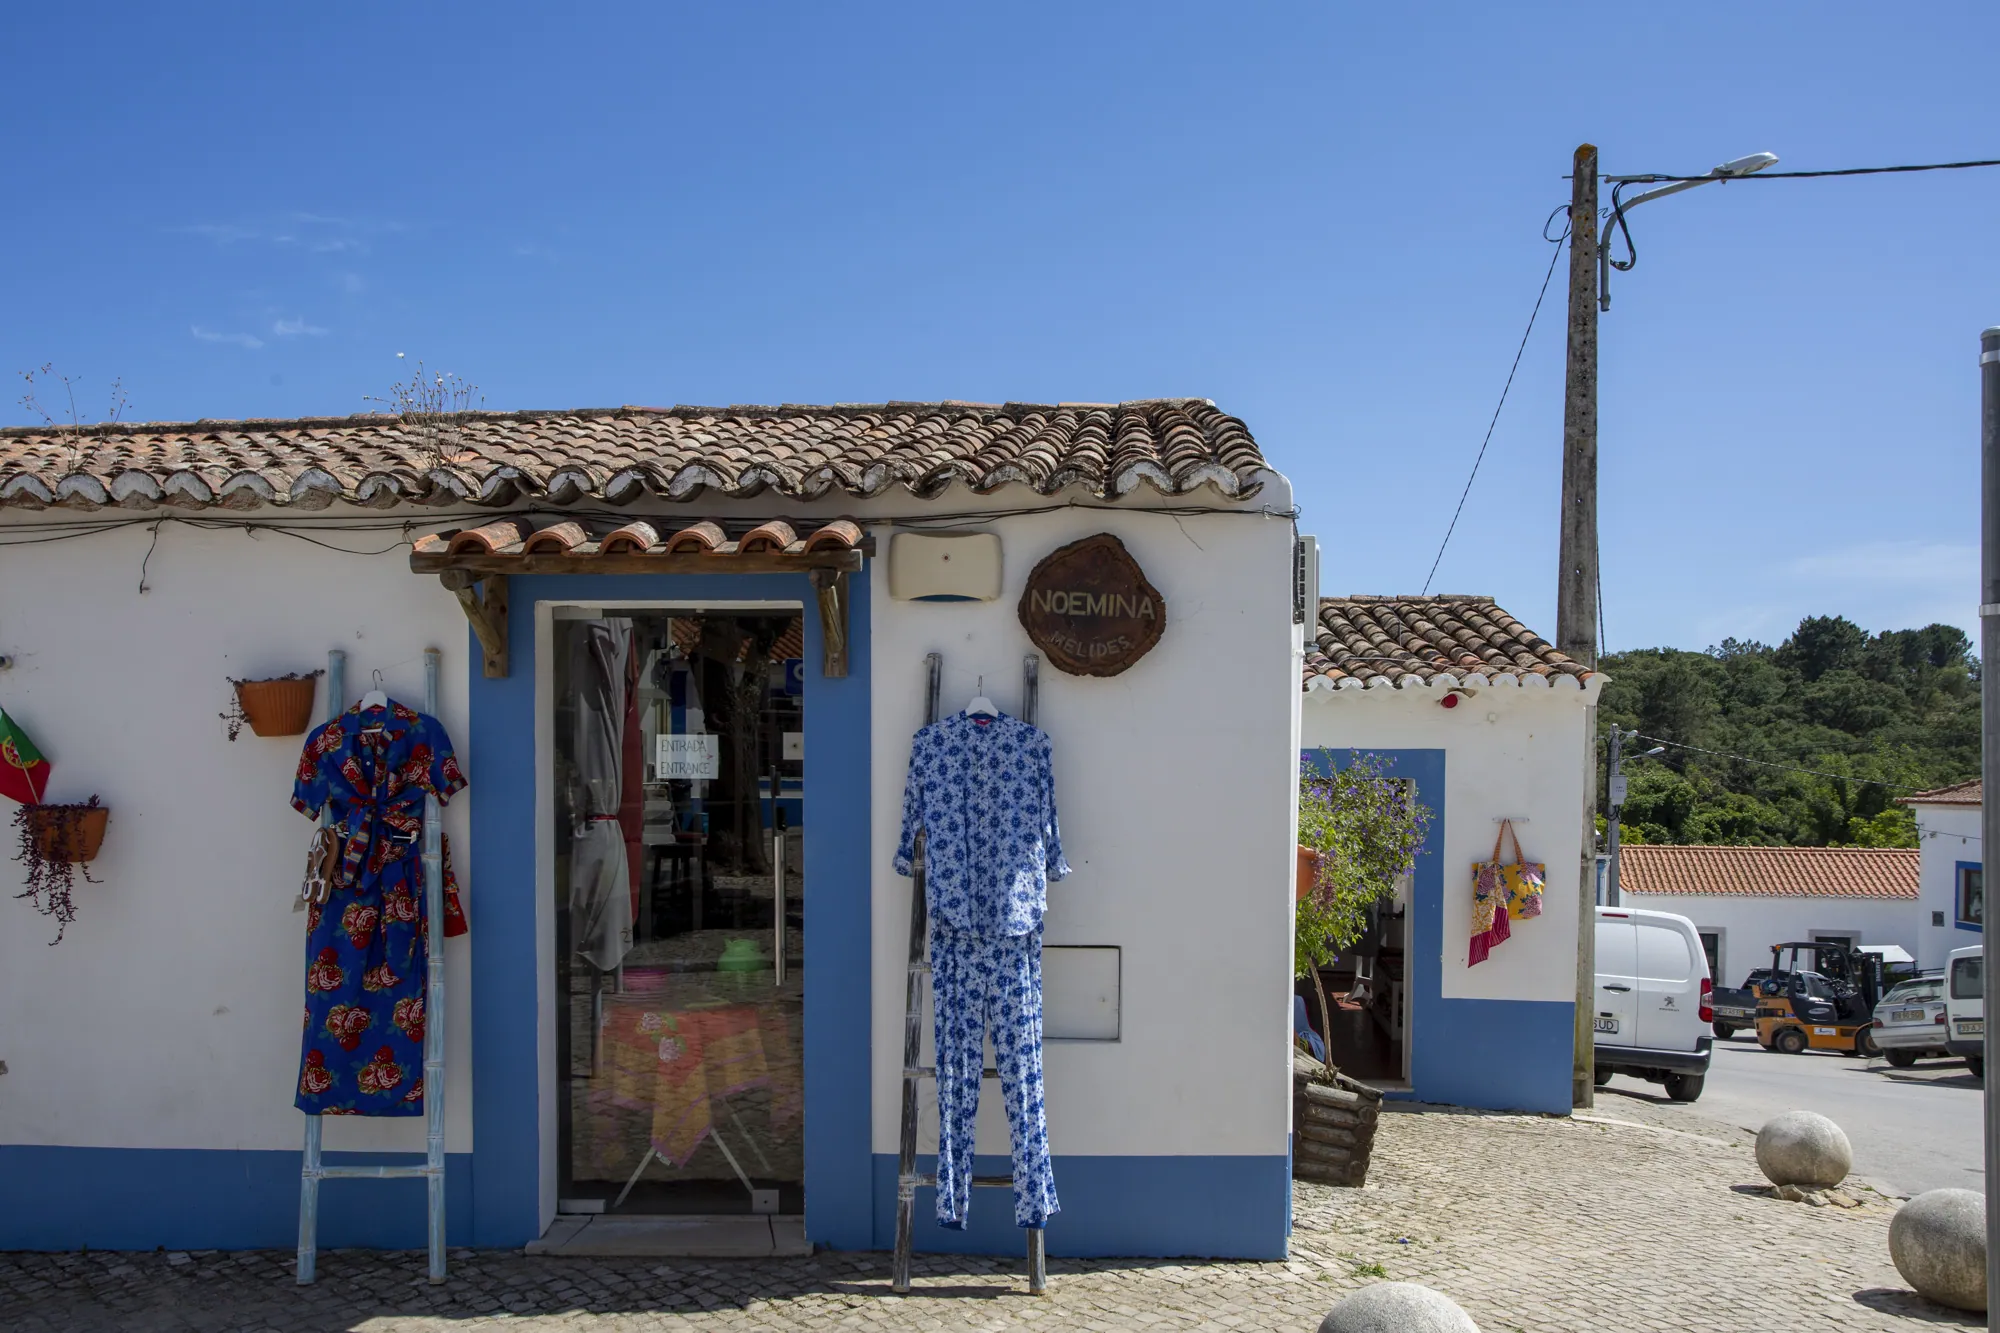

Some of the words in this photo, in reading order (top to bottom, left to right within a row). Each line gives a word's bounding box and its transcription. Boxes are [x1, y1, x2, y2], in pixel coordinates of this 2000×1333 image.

[1030, 588, 1156, 620] NOEMINA
[661, 740, 707, 753] ENTRADA
[660, 761, 711, 775] ENTRANCE
